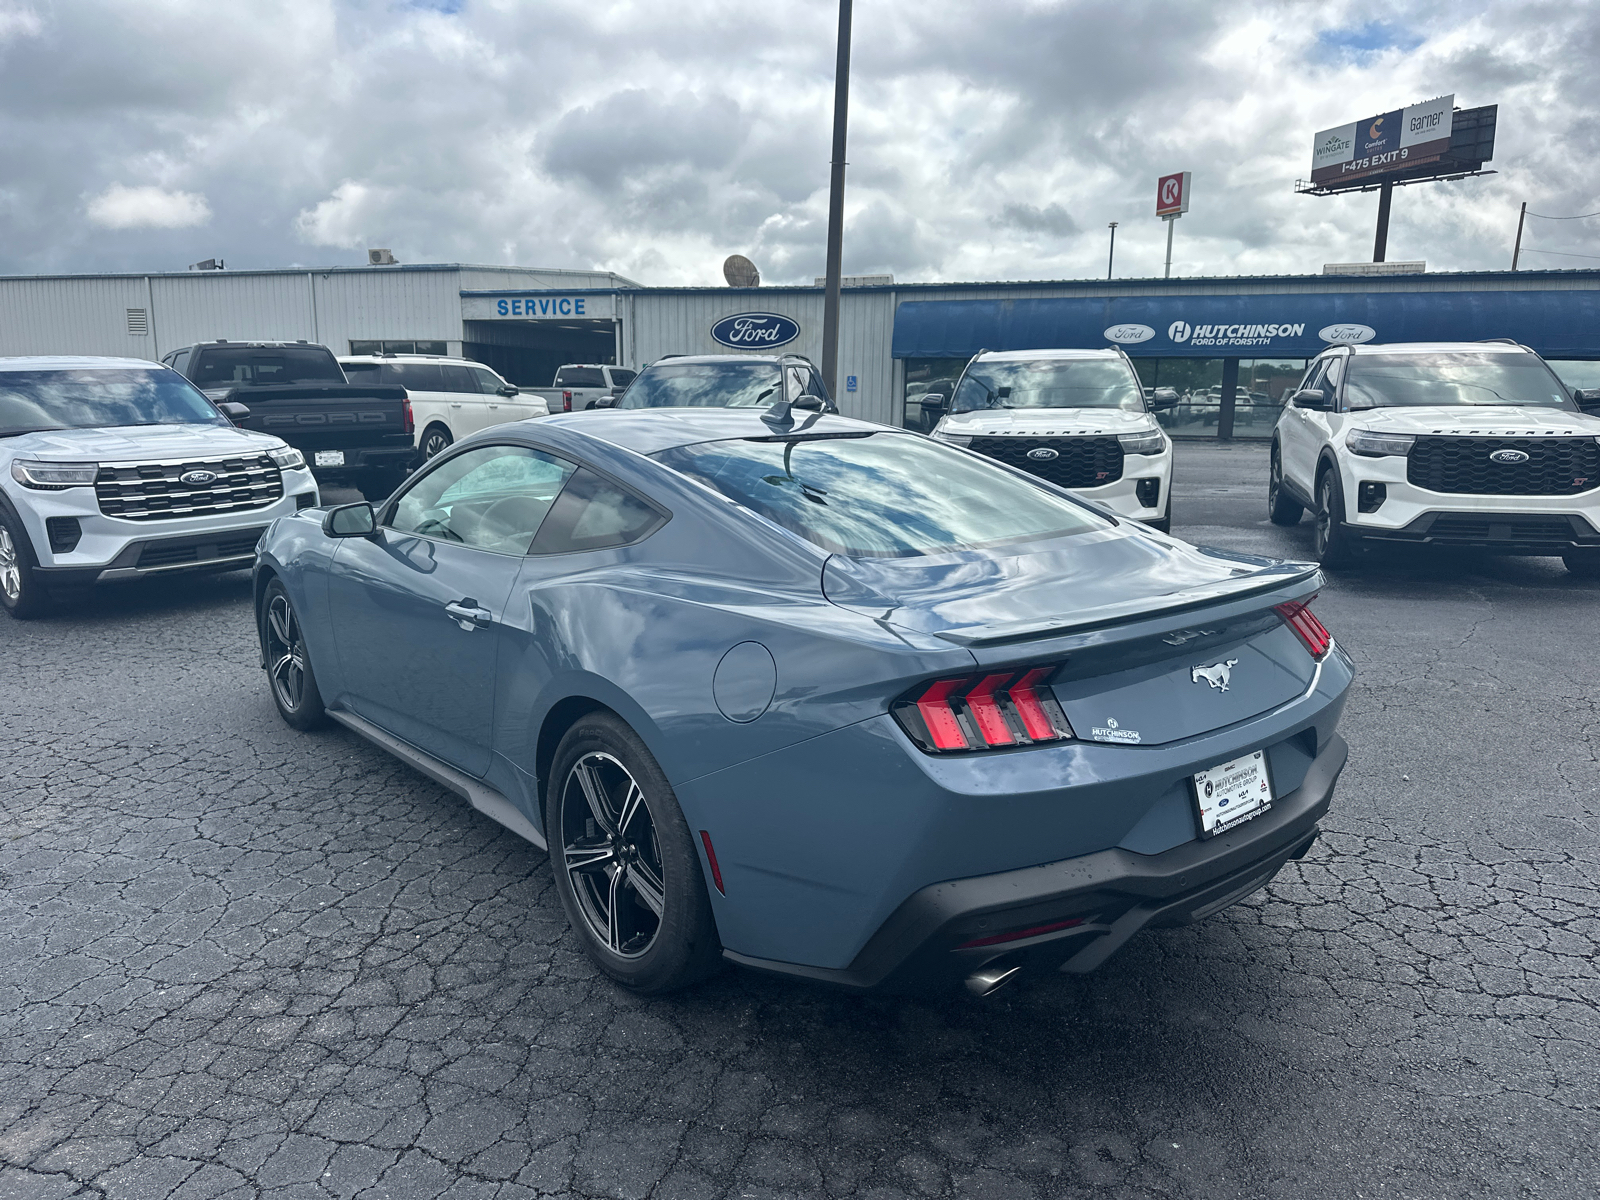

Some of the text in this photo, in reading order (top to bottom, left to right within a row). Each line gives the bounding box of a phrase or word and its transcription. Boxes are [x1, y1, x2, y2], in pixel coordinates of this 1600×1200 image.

[1410, 111, 1444, 132] Garner
[1316, 140, 1350, 156] WINGATE
[1364, 139, 1386, 149] Comfort
[1342, 158, 1369, 173] I-475
[1371, 150, 1399, 166] EXIT
[1401, 148, 1409, 159] 9
[1165, 182, 1177, 202] K
[497, 299, 585, 315] SERVICE
[729, 317, 781, 341] Ford
[1114, 327, 1145, 339] Ford
[1193, 323, 1305, 338] HUTCHINSON
[1331, 327, 1362, 339] Ford
[262, 411, 387, 426] FORD
[1034, 450, 1051, 458] Ford
[1499, 453, 1521, 461] Ford
[189, 473, 209, 482] Ford
[1095, 471, 1110, 480] ST
[1572, 478, 1588, 486] ST
[1092, 729, 1138, 739] HUTCHINSON
[1214, 764, 1258, 791] HUTCHINSON
[1216, 775, 1257, 797] AUTOMOTIVE GROUP
[1212, 803, 1272, 836] Hutchinsonautogroup.com
